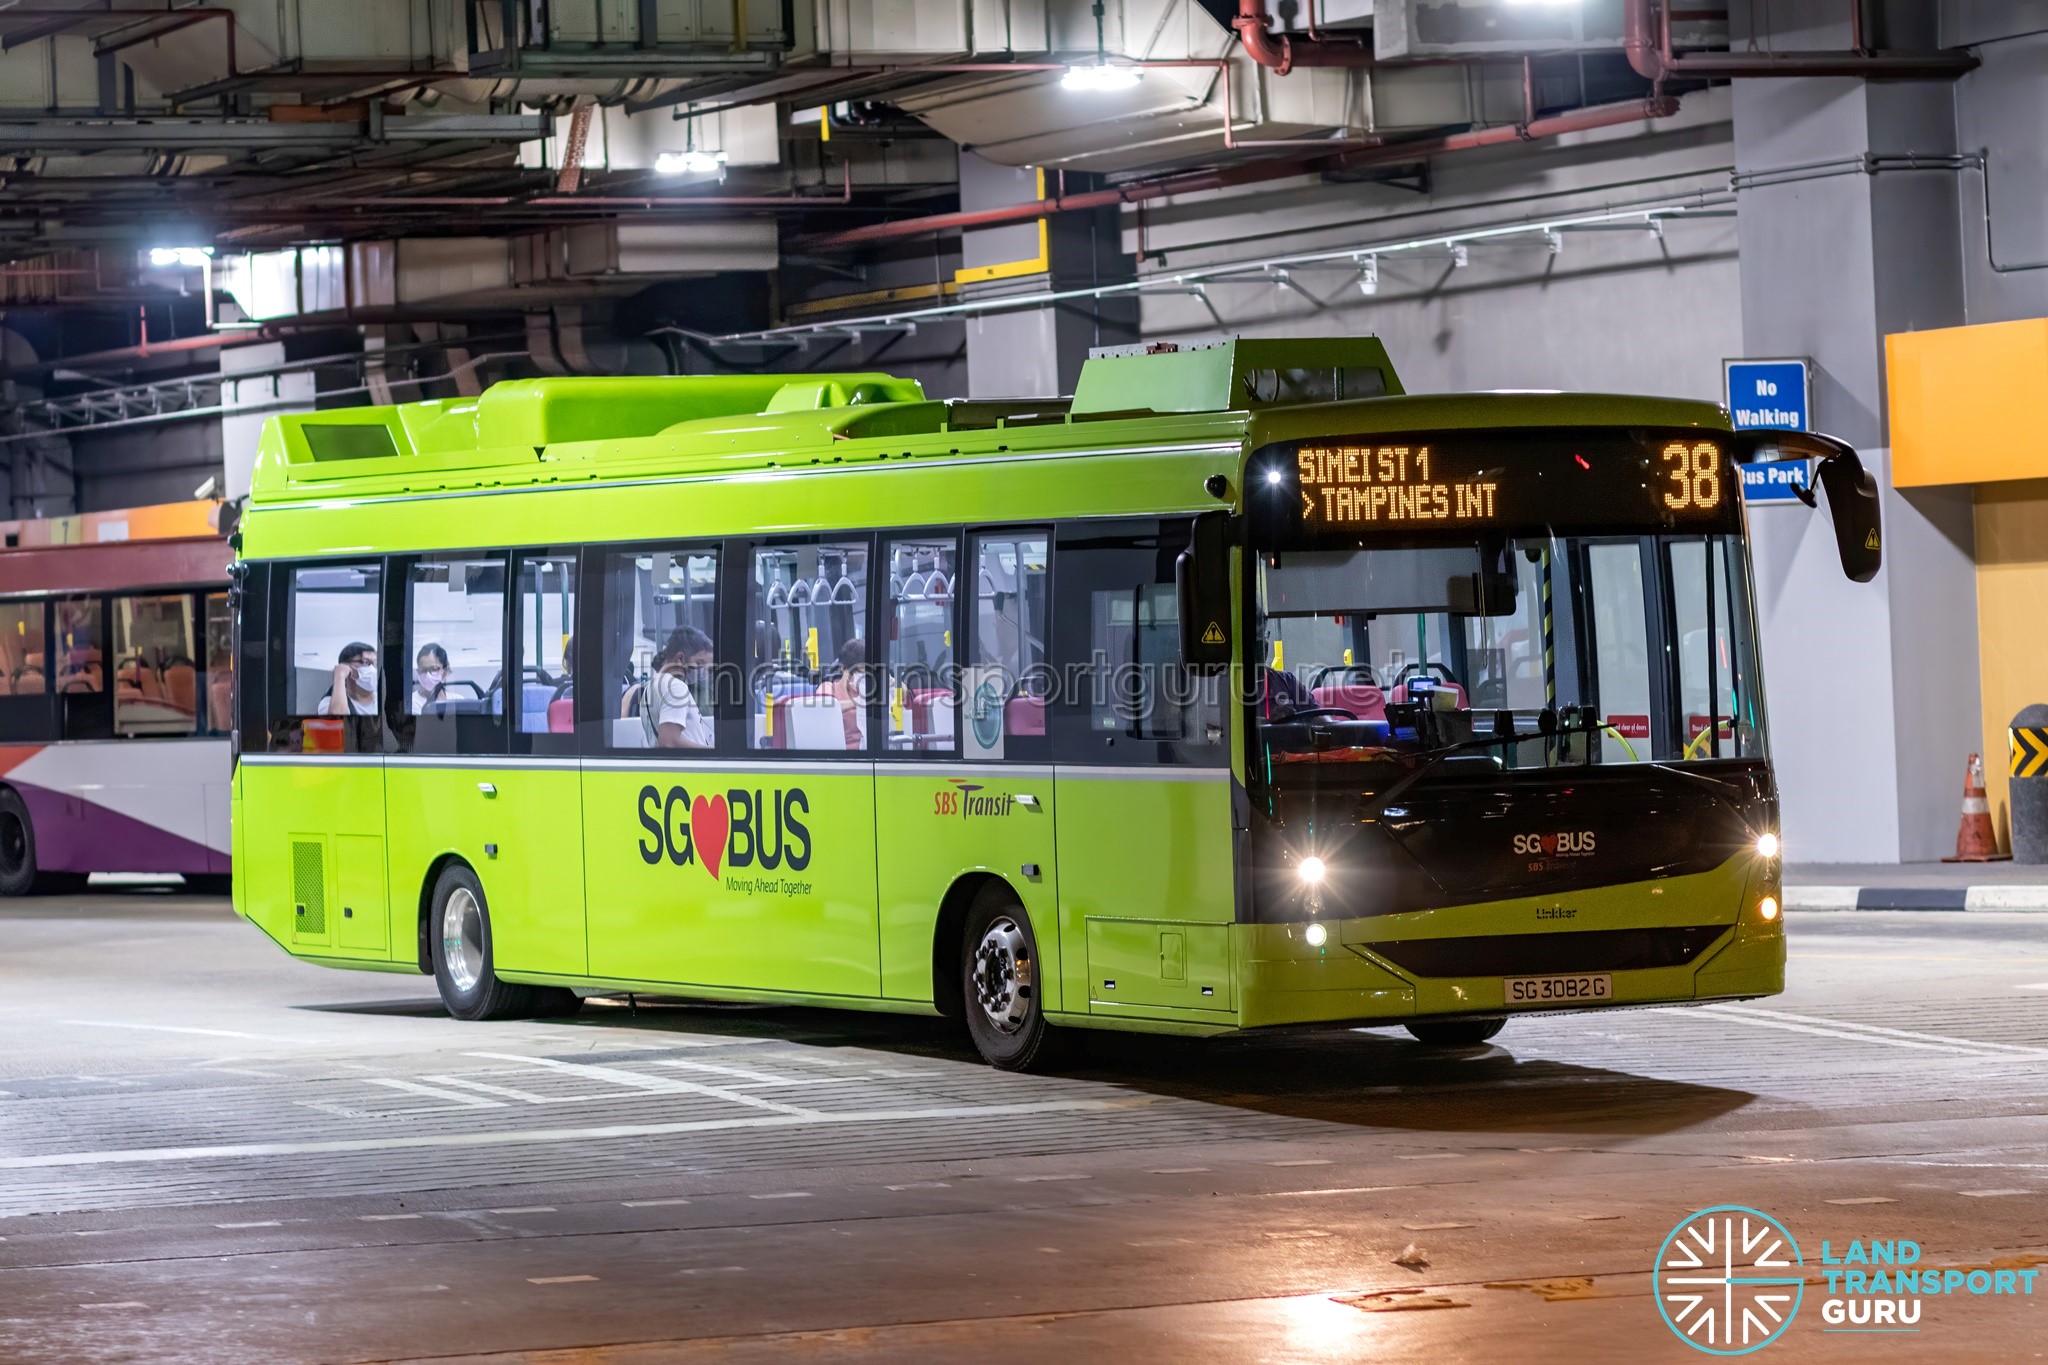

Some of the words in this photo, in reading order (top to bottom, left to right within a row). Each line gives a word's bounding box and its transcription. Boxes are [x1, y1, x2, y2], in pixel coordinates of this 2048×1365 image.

[1756, 379, 1777, 396] No
[1736, 408, 1799, 428] Walking
[1299, 449, 1371, 483] SIMEI
[1378, 447, 1409, 481] ST
[1416, 447, 1428, 480] 1
[1664, 443, 1719, 508] 38
[1768, 467, 1804, 484] Park
[1322, 484, 1449, 520] TAMPINES
[1455, 483, 1496, 517] INT
[934, 791, 958, 815] SBS
[956, 784, 1016, 821] Transit
[726, 877, 753, 895] Moving
[754, 878, 778, 893] Ahead
[780, 879, 812, 897] Together
